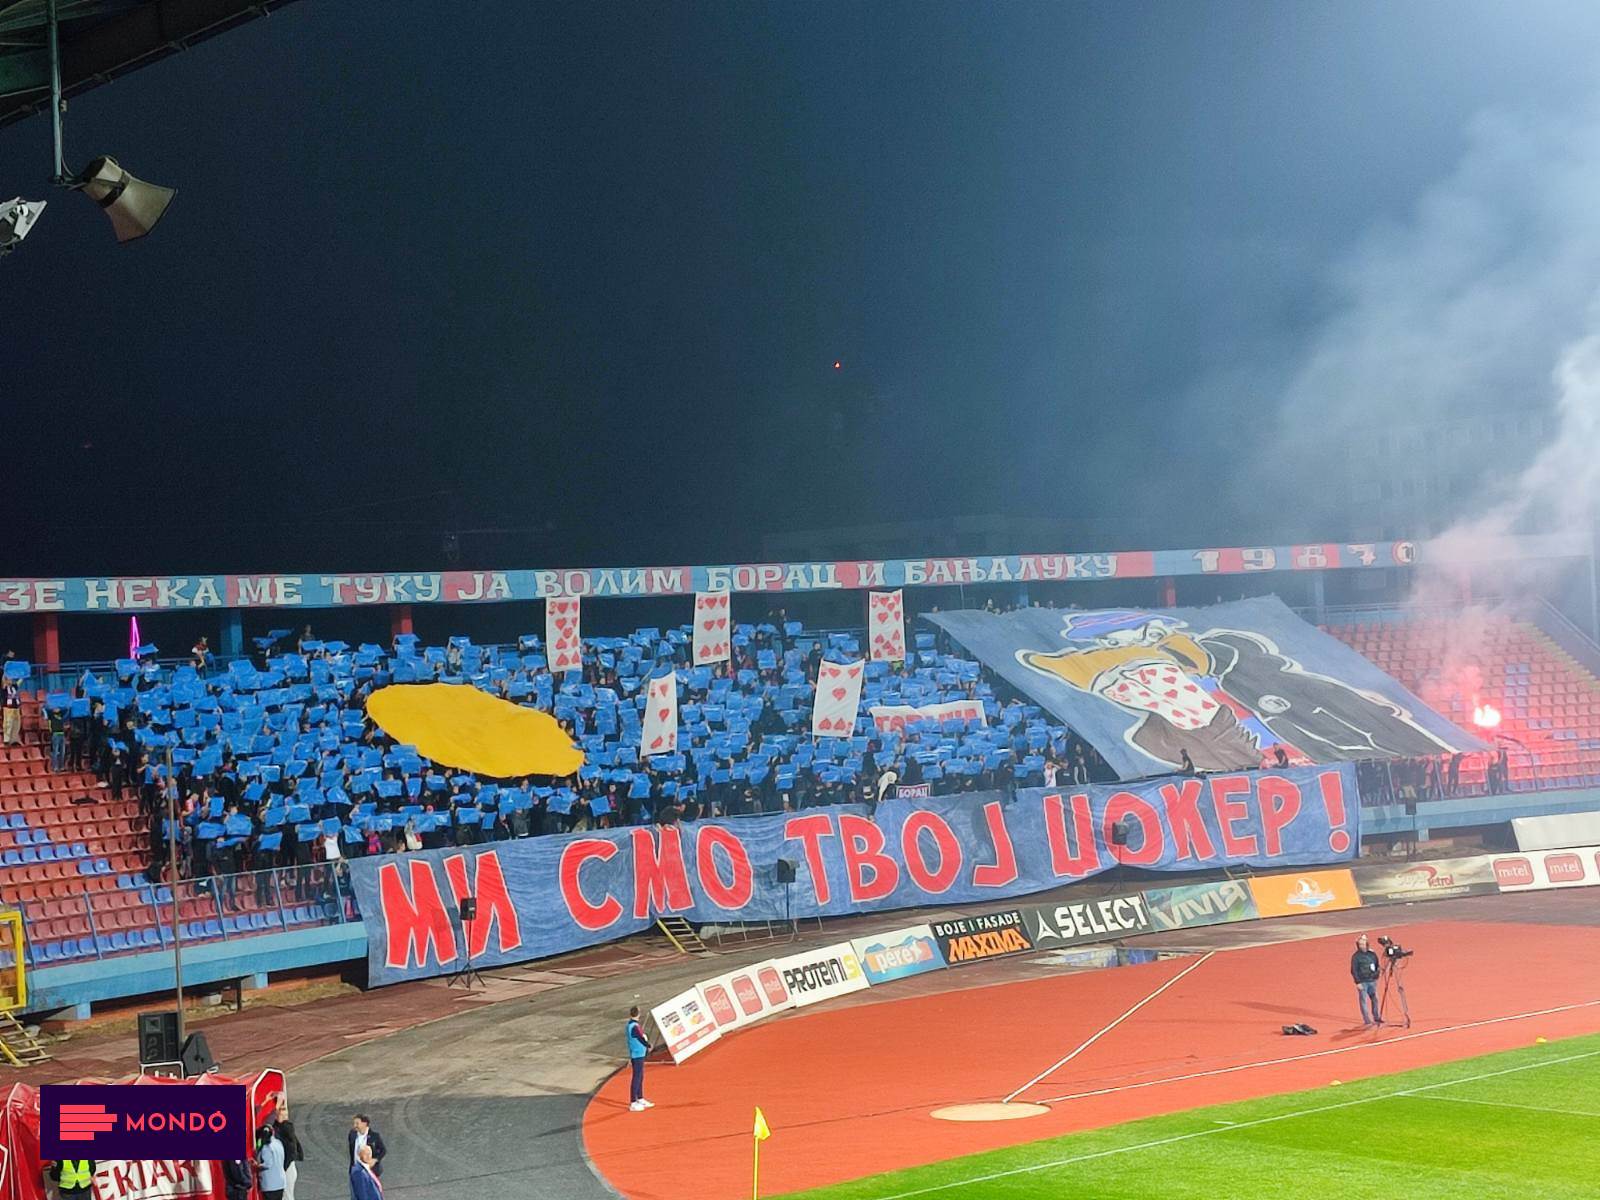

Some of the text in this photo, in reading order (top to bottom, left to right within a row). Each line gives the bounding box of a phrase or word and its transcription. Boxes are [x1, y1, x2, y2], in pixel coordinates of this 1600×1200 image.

[85, 577, 220, 608] НЕКА
[237, 577, 302, 605] МЕ
[320, 574, 442, 604] ТУКУ
[457, 572, 513, 600] ЈА
[534, 568, 684, 597] ВОЛИМ
[706, 564, 842, 592] БОРАЦ
[857, 562, 885, 586] И
[903, 555, 1118, 584] БАЊАЛУКУ
[379, 850, 521, 969] МИ
[559, 825, 753, 931] СМО
[784, 800, 1019, 905] ТВОЈ
[935, 912, 1021, 937] BOJE I FASADE
[1054, 896, 1147, 939] SELECT
[948, 927, 1032, 963] MAXIMA
